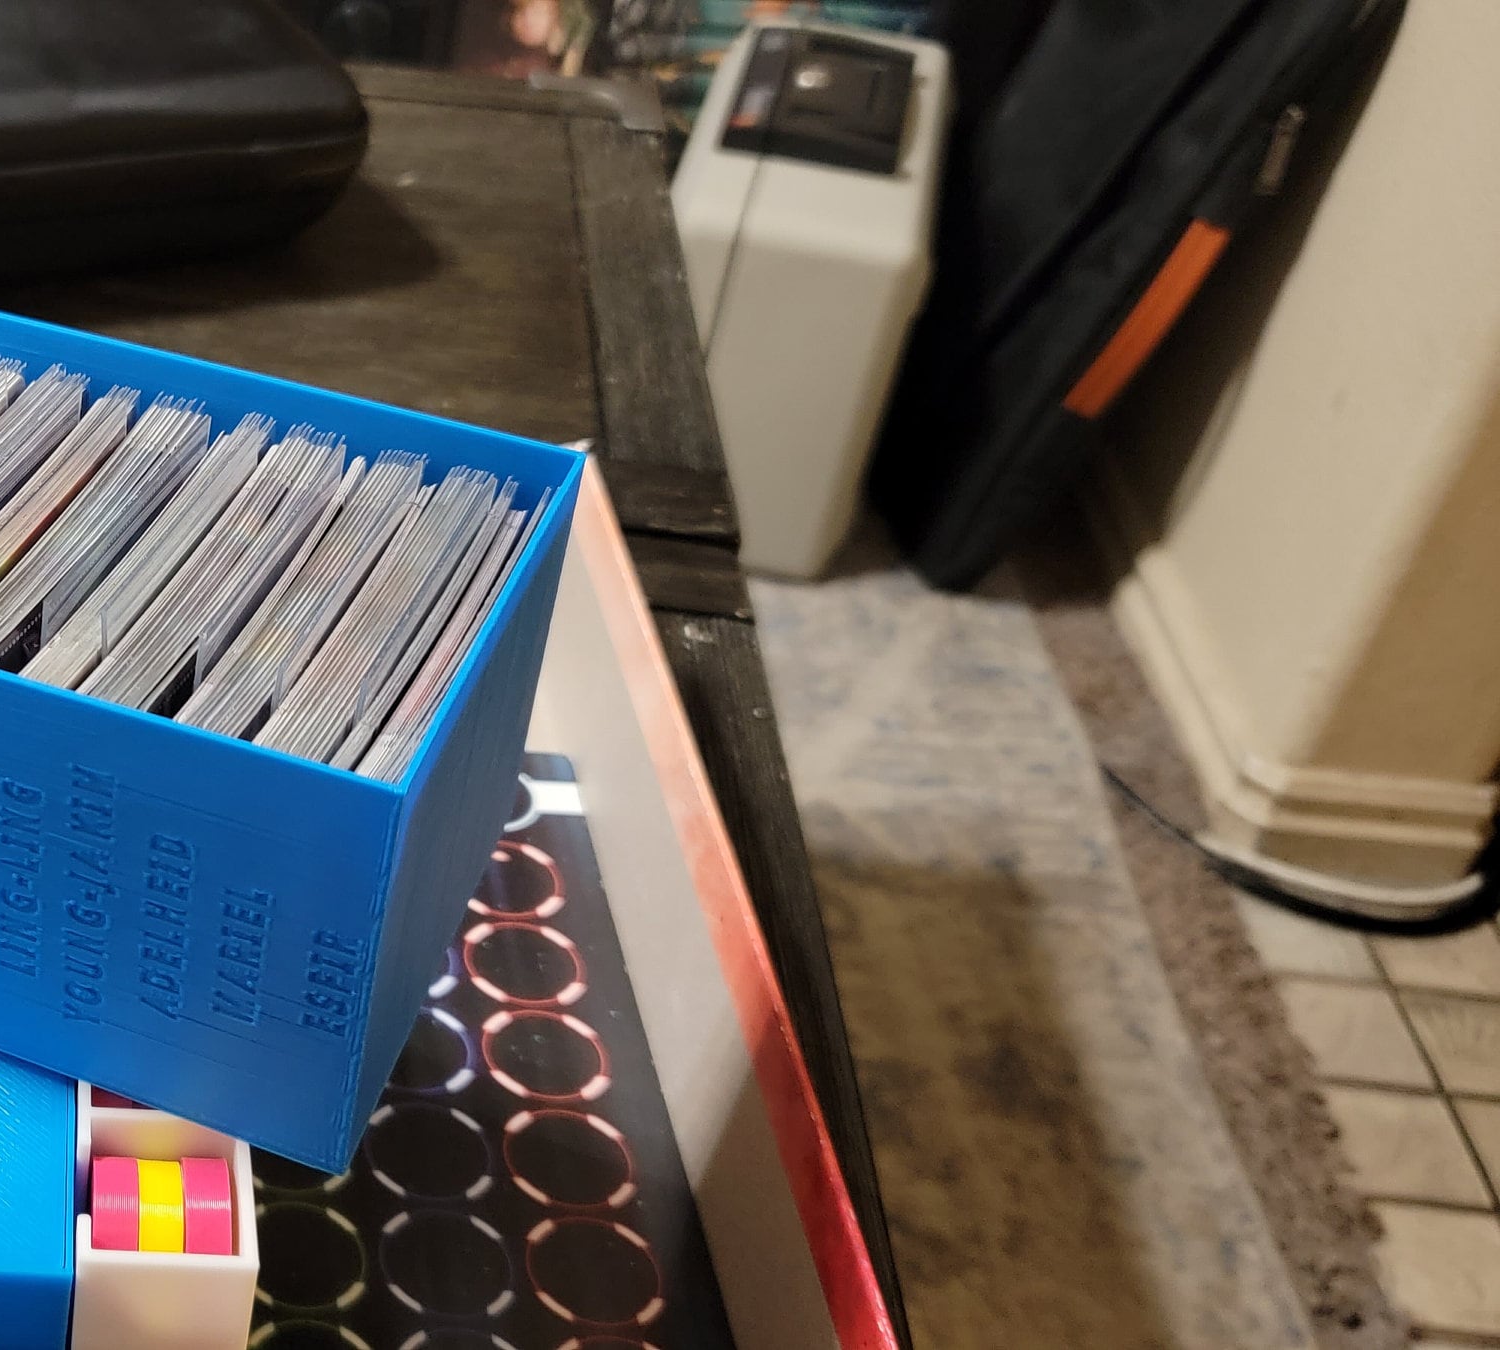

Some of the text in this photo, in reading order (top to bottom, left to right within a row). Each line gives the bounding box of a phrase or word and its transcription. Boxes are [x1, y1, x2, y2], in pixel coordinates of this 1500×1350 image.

[139, 833, 195, 1021] ADELHEID
[209, 886, 274, 1026] MARIEL
[299, 928, 361, 1038] ESFIR
